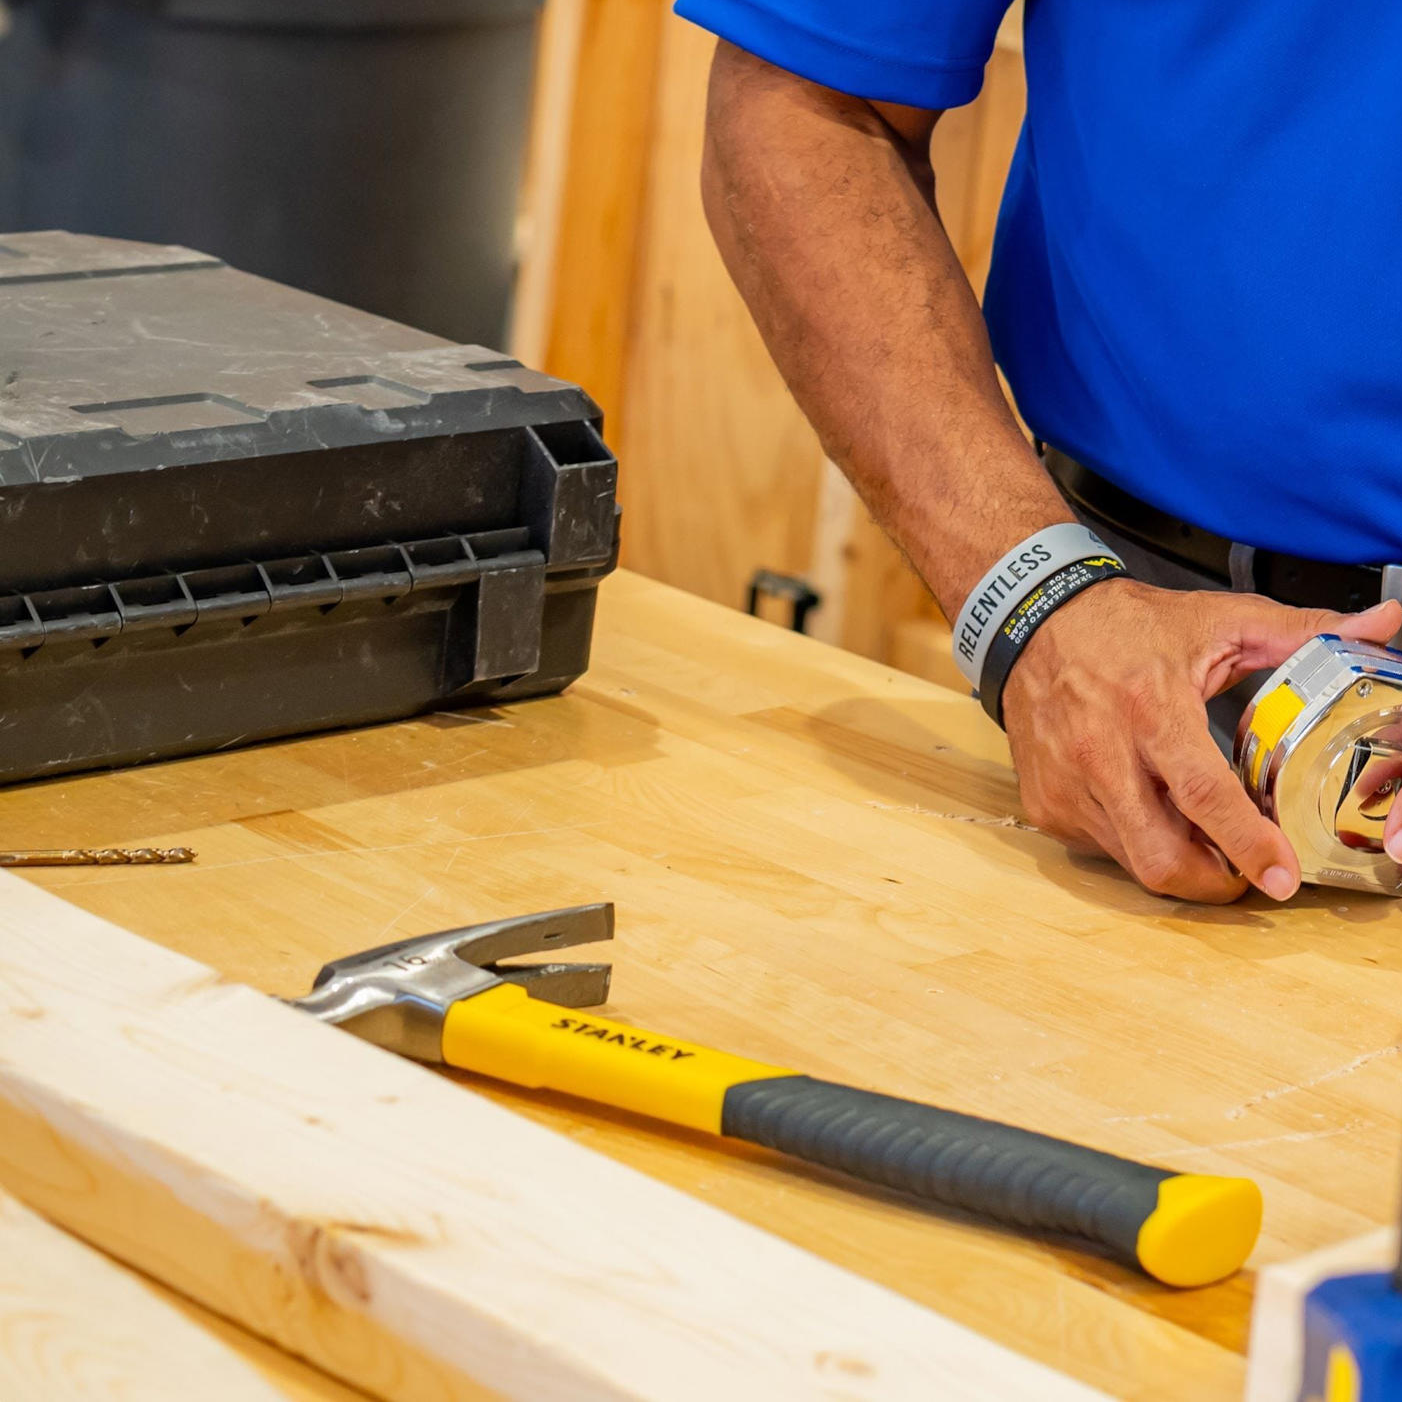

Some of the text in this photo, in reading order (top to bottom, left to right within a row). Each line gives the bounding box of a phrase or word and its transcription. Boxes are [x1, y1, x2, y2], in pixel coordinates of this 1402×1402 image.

[1069, 563, 1083, 573] TO
[1047, 580, 1066, 596] WILL
[958, 544, 1052, 663] RELENTLESS
[1017, 588, 1044, 616] JAMES
[1026, 595, 1048, 617] DRAW
[1043, 589, 1066, 610] NEAR
[1008, 616, 1027, 640] NEAR
[1029, 612, 1042, 624] TO
[1014, 626, 1029, 644] GOD
[382, 955, 428, 971] 16
[551, 1018, 696, 1060] STANLEY
